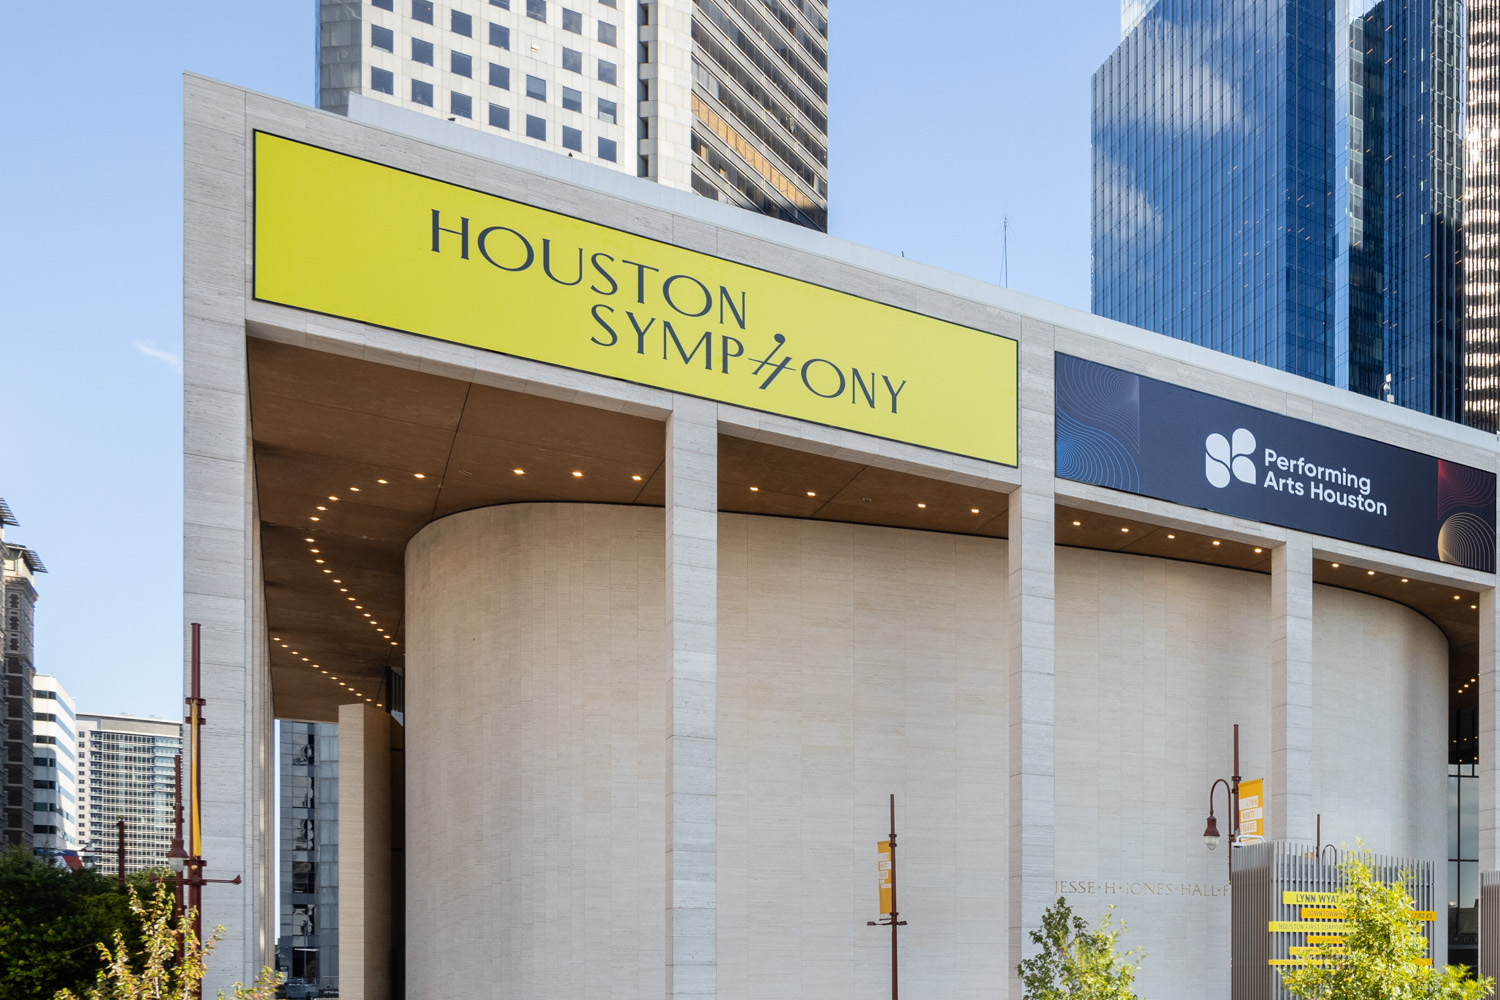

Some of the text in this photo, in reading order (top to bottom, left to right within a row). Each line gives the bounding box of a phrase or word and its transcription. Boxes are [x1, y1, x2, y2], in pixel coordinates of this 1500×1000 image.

[431, 208, 747, 330] HOUSTON
[1264, 470, 1388, 516] Arts Houston
[1265, 447, 1371, 495] Performing
[1054, 880, 1096, 895] JESSE
[1125, 882, 1174, 896] JONES
[1180, 883, 1218, 897] HALL
[1296, 894, 1341, 904] LYNN WYAT
